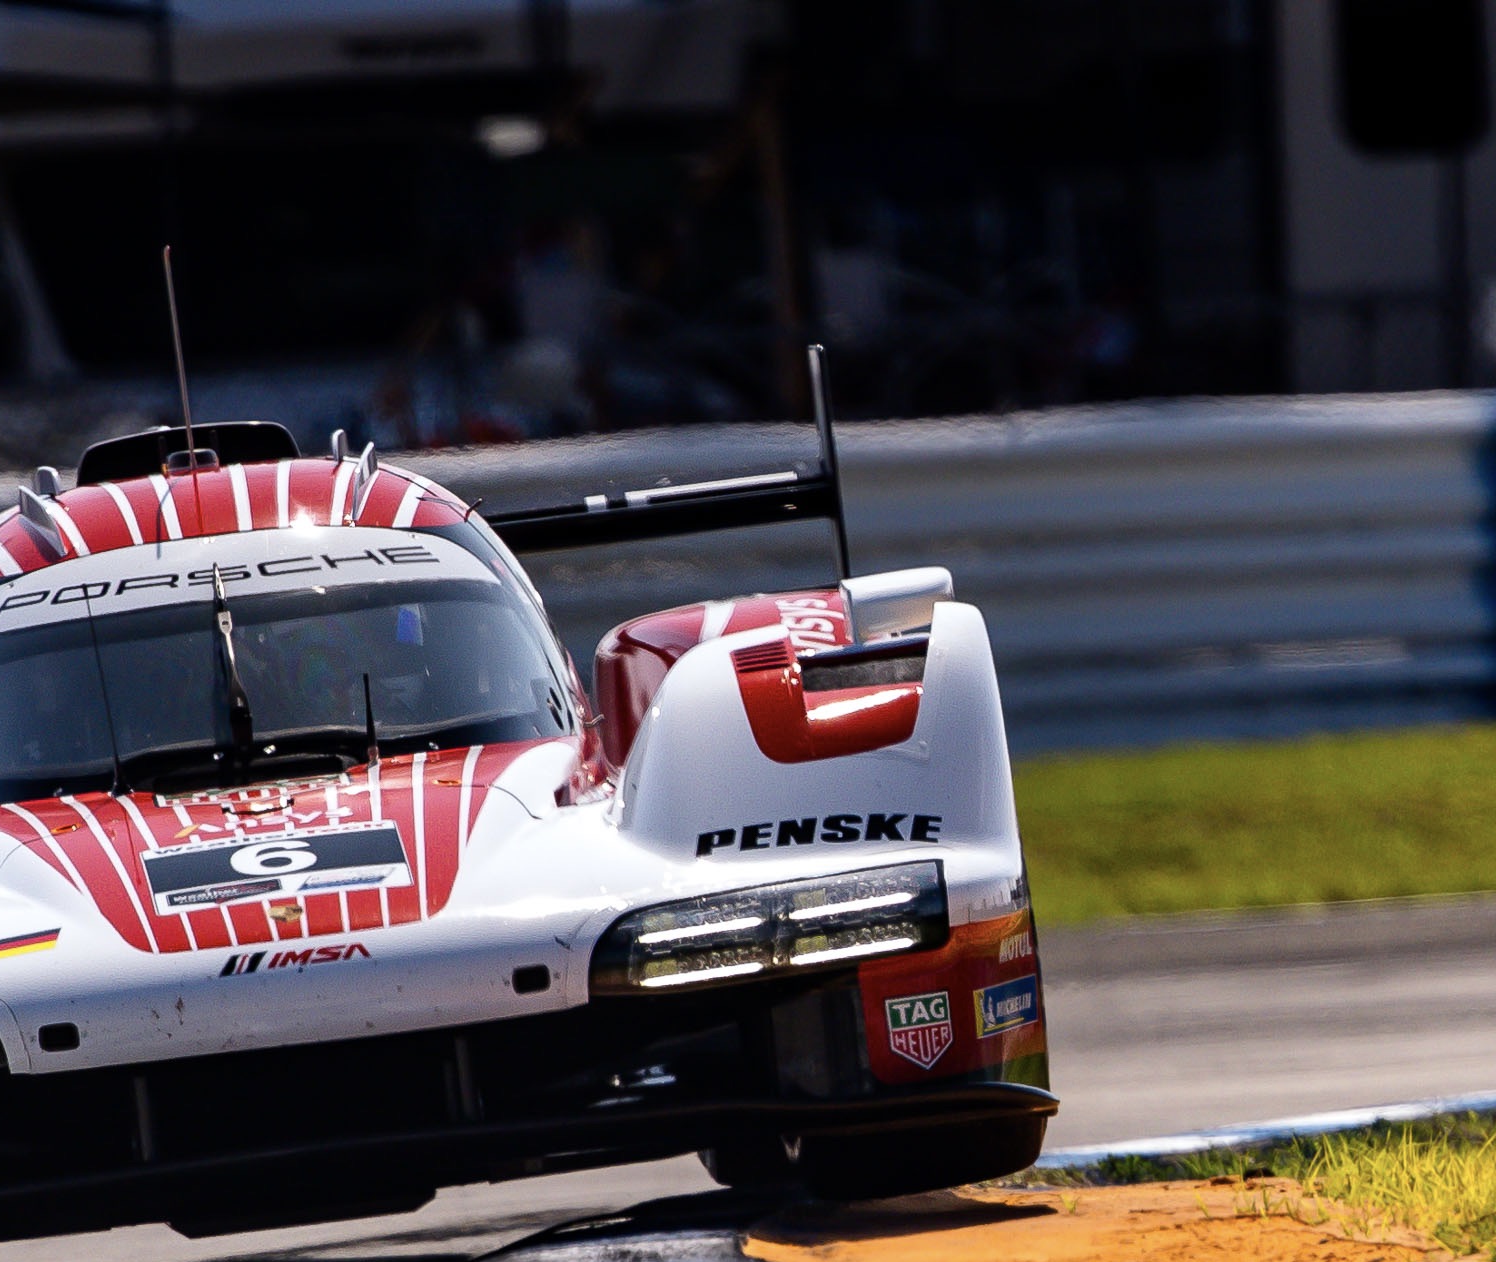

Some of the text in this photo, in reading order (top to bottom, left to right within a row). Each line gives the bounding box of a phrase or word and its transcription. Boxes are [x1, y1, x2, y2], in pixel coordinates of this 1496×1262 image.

[695, 813, 943, 858] PENSKE
[230, 841, 318, 876] 6
[267, 942, 372, 969] IMSA
[998, 931, 1033, 964] MOTUL
[891, 998, 946, 1025] TAG
[996, 992, 1032, 1018] MICHELIN
[895, 1026, 950, 1063] HEUER
